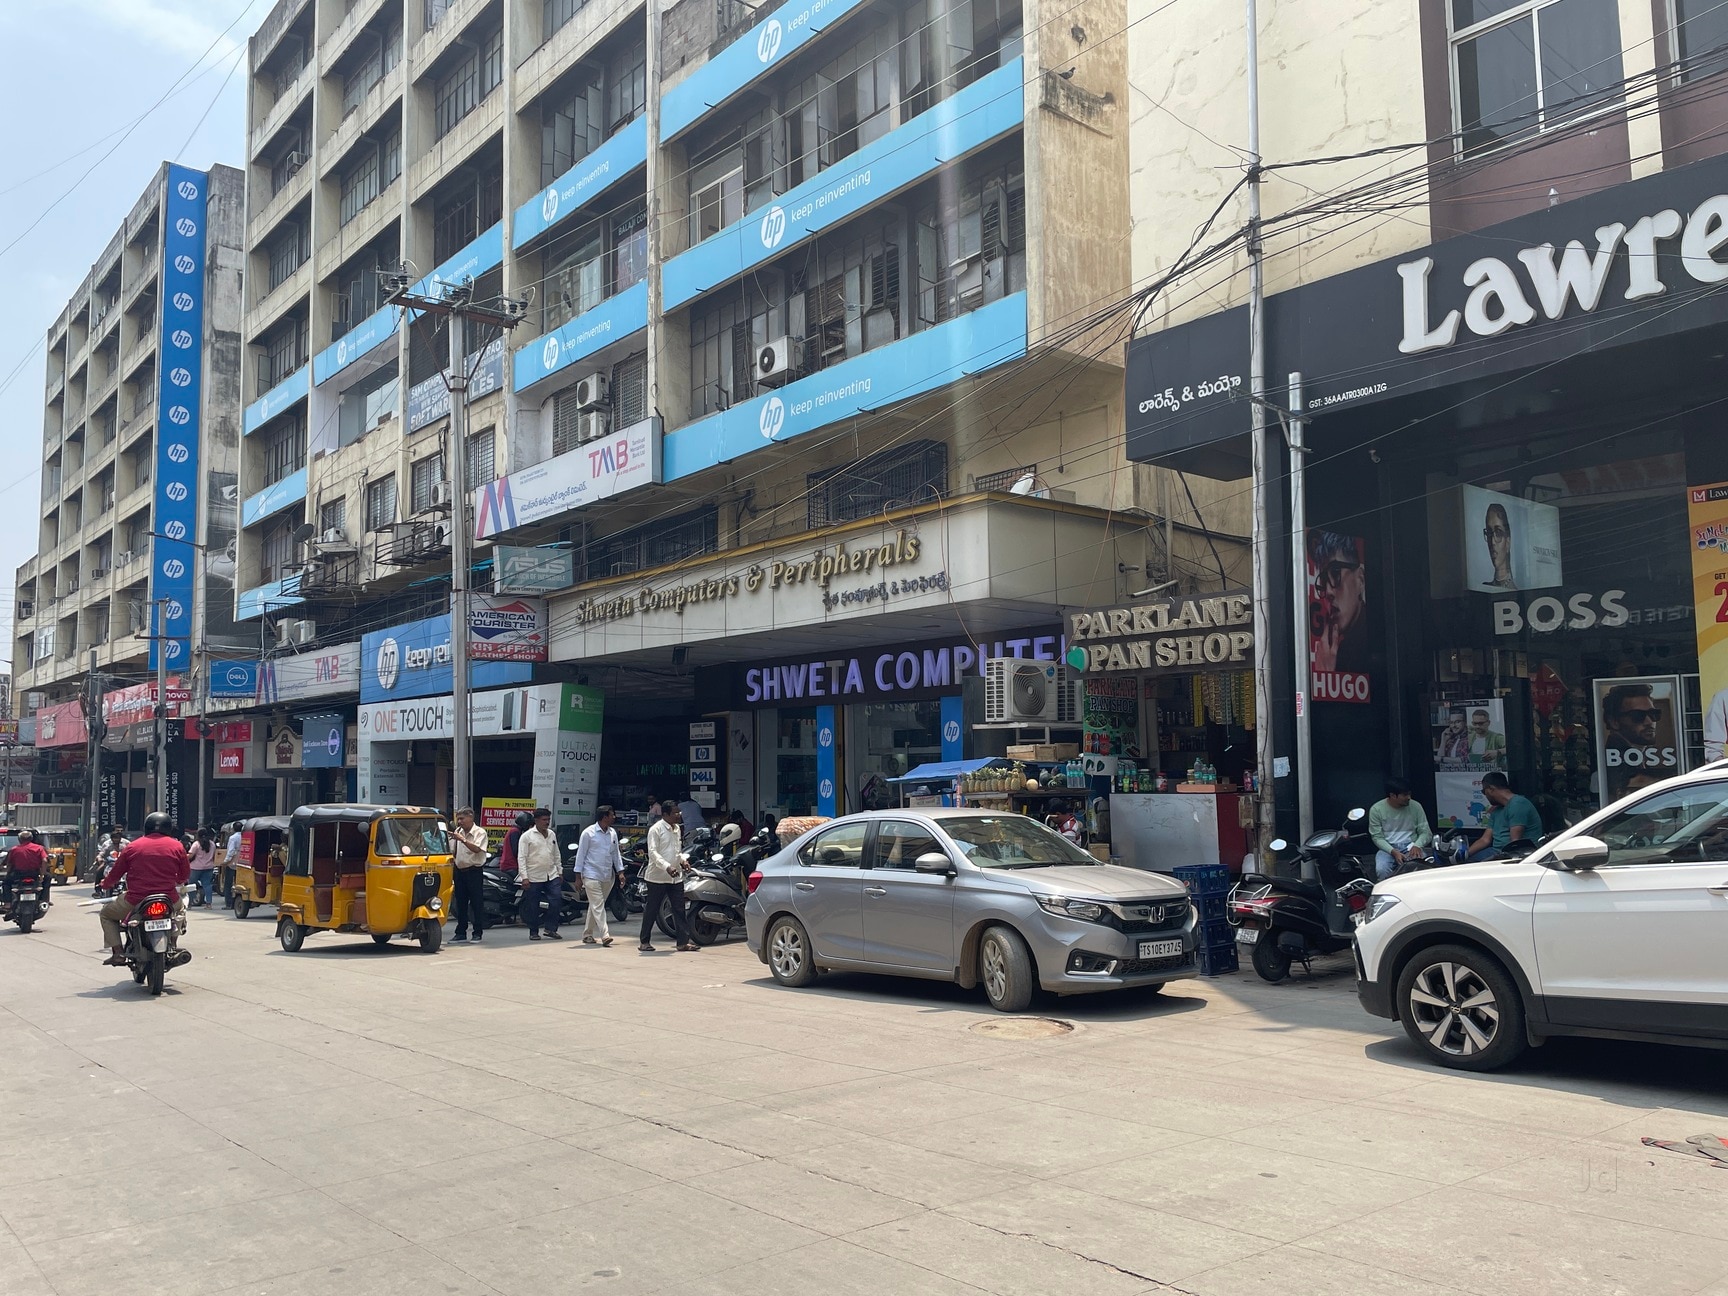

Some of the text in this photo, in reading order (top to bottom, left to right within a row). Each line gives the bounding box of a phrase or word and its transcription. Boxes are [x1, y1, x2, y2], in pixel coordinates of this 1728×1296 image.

[759, 19, 781, 63] hp
[787, 11, 809, 33] keep
[179, 181, 197, 200] hp
[561, 184, 575, 201] keep
[575, 160, 609, 193] reinventing
[762, 169, 871, 249] hp keep reinventing
[177, 217, 195, 238] hp
[176, 255, 194, 274] hp
[174, 292, 192, 312] hp
[173, 329, 191, 349] hp
[544, 336, 558, 370] hp
[576, 319, 611, 345] reinventing
[172, 367, 190, 387] hp
[1182, 385, 1195, 402] &
[1308, 398, 1323, 409] GST:
[170, 405, 188, 425] hp
[761, 378, 871, 438] hp keep reinventing
[169, 443, 187, 463] hp
[588, 440, 628, 479] TMB
[167, 481, 186, 502] hp
[166, 520, 185, 540] hp
[164, 559, 183, 579] hp
[504, 556, 566, 574] ASUS
[576, 529, 921, 624] Shweta Computers & Peripherals
[1714, 572, 1727, 580] GET
[468, 610, 536, 622] AMERICAN
[1070, 594, 1253, 641] PARKLANE
[1493, 589, 1629, 636] BOSS
[466, 619, 536, 629] TOURISTER
[405, 645, 432, 670] keep
[1088, 631, 1255, 672] PAN SHOP
[746, 658, 865, 703] SHWETA
[1313, 672, 1369, 700] HUGO
[153, 691, 188, 699] Lnovo
[1090, 696, 1135, 713] PAN SHOP
[374, 706, 444, 733] ONE TOUCH
[820, 727, 832, 747] hp
[944, 720, 959, 743] hp
[561, 740, 596, 751] ULTRA
[220, 753, 240, 768] Lenovo
[561, 751, 597, 762] TOUCH
[1605, 747, 1677, 768] BOSS
[691, 771, 714, 782] DELL
[820, 778, 832, 798] hp
[484, 809, 493, 817] ALL
[493, 810, 505, 818] TYPE
[505, 810, 512, 818] OF
[486, 817, 505, 826] SERVICE
[1142, 941, 1182, 956] TS10EY3745
